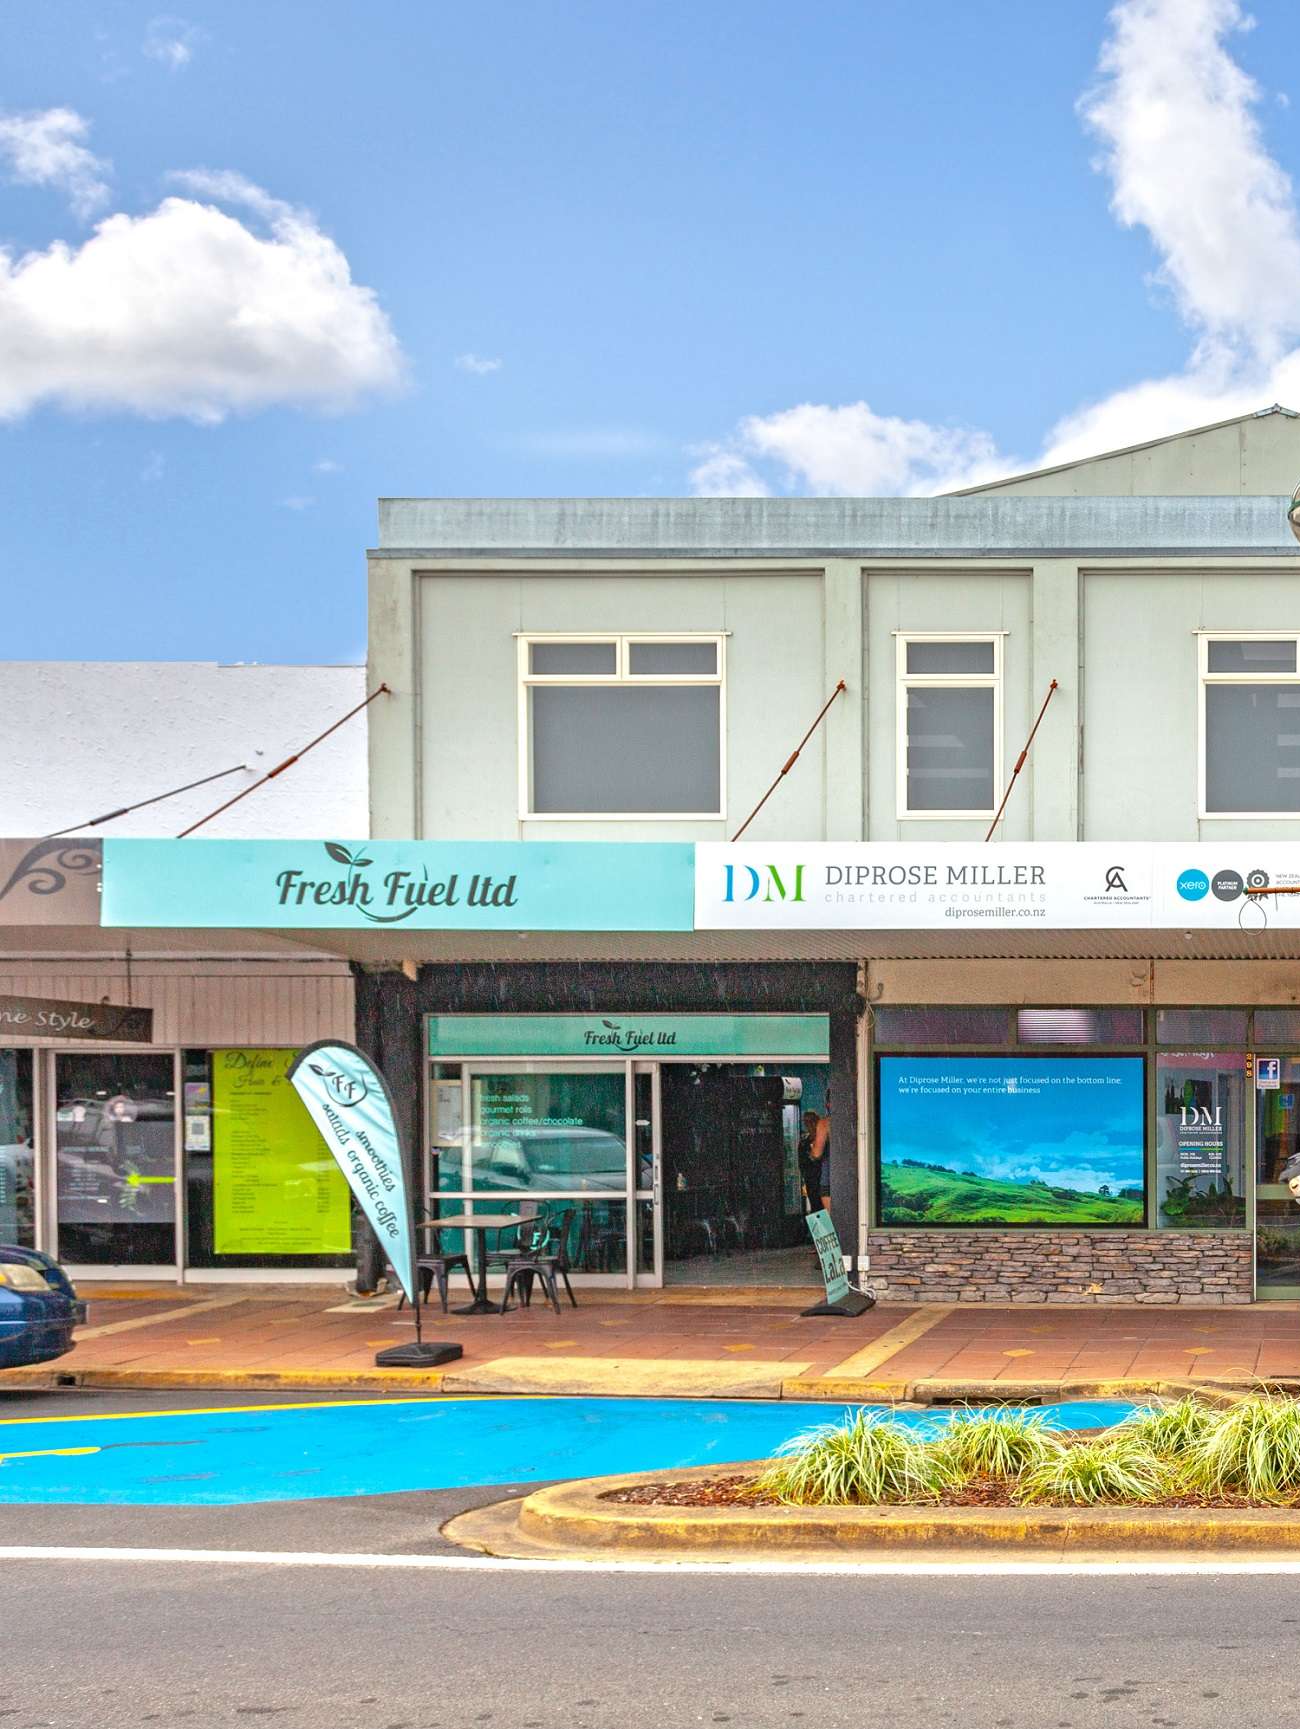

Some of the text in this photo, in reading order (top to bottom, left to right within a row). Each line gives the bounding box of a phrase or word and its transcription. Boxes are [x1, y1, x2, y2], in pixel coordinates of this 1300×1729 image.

[723, 865, 807, 902] DM
[825, 866, 1046, 885] DIPROSE MILLER
[276, 870, 518, 907] Fresh Fuel ltd
[1180, 881, 1207, 890] xero
[825, 891, 1046, 903] chartered accountants
[945, 907, 1046, 919] diprosemiller.co.nz
[35, 1010, 94, 1031] Style
[584, 1031, 677, 1045] Fresh Fuel ltd
[909, 1077, 939, 1085] Diprose
[921, 1086, 950, 1094] focused
[964, 1088, 982, 1096] your
[1008, 1086, 1041, 1094] business
[1180, 1106, 1223, 1126] DM
[322, 1103, 350, 1146] salads
[347, 1150, 380, 1201] organic
[375, 1200, 400, 1239] coffee
[355, 1130, 396, 1193] smoothies
